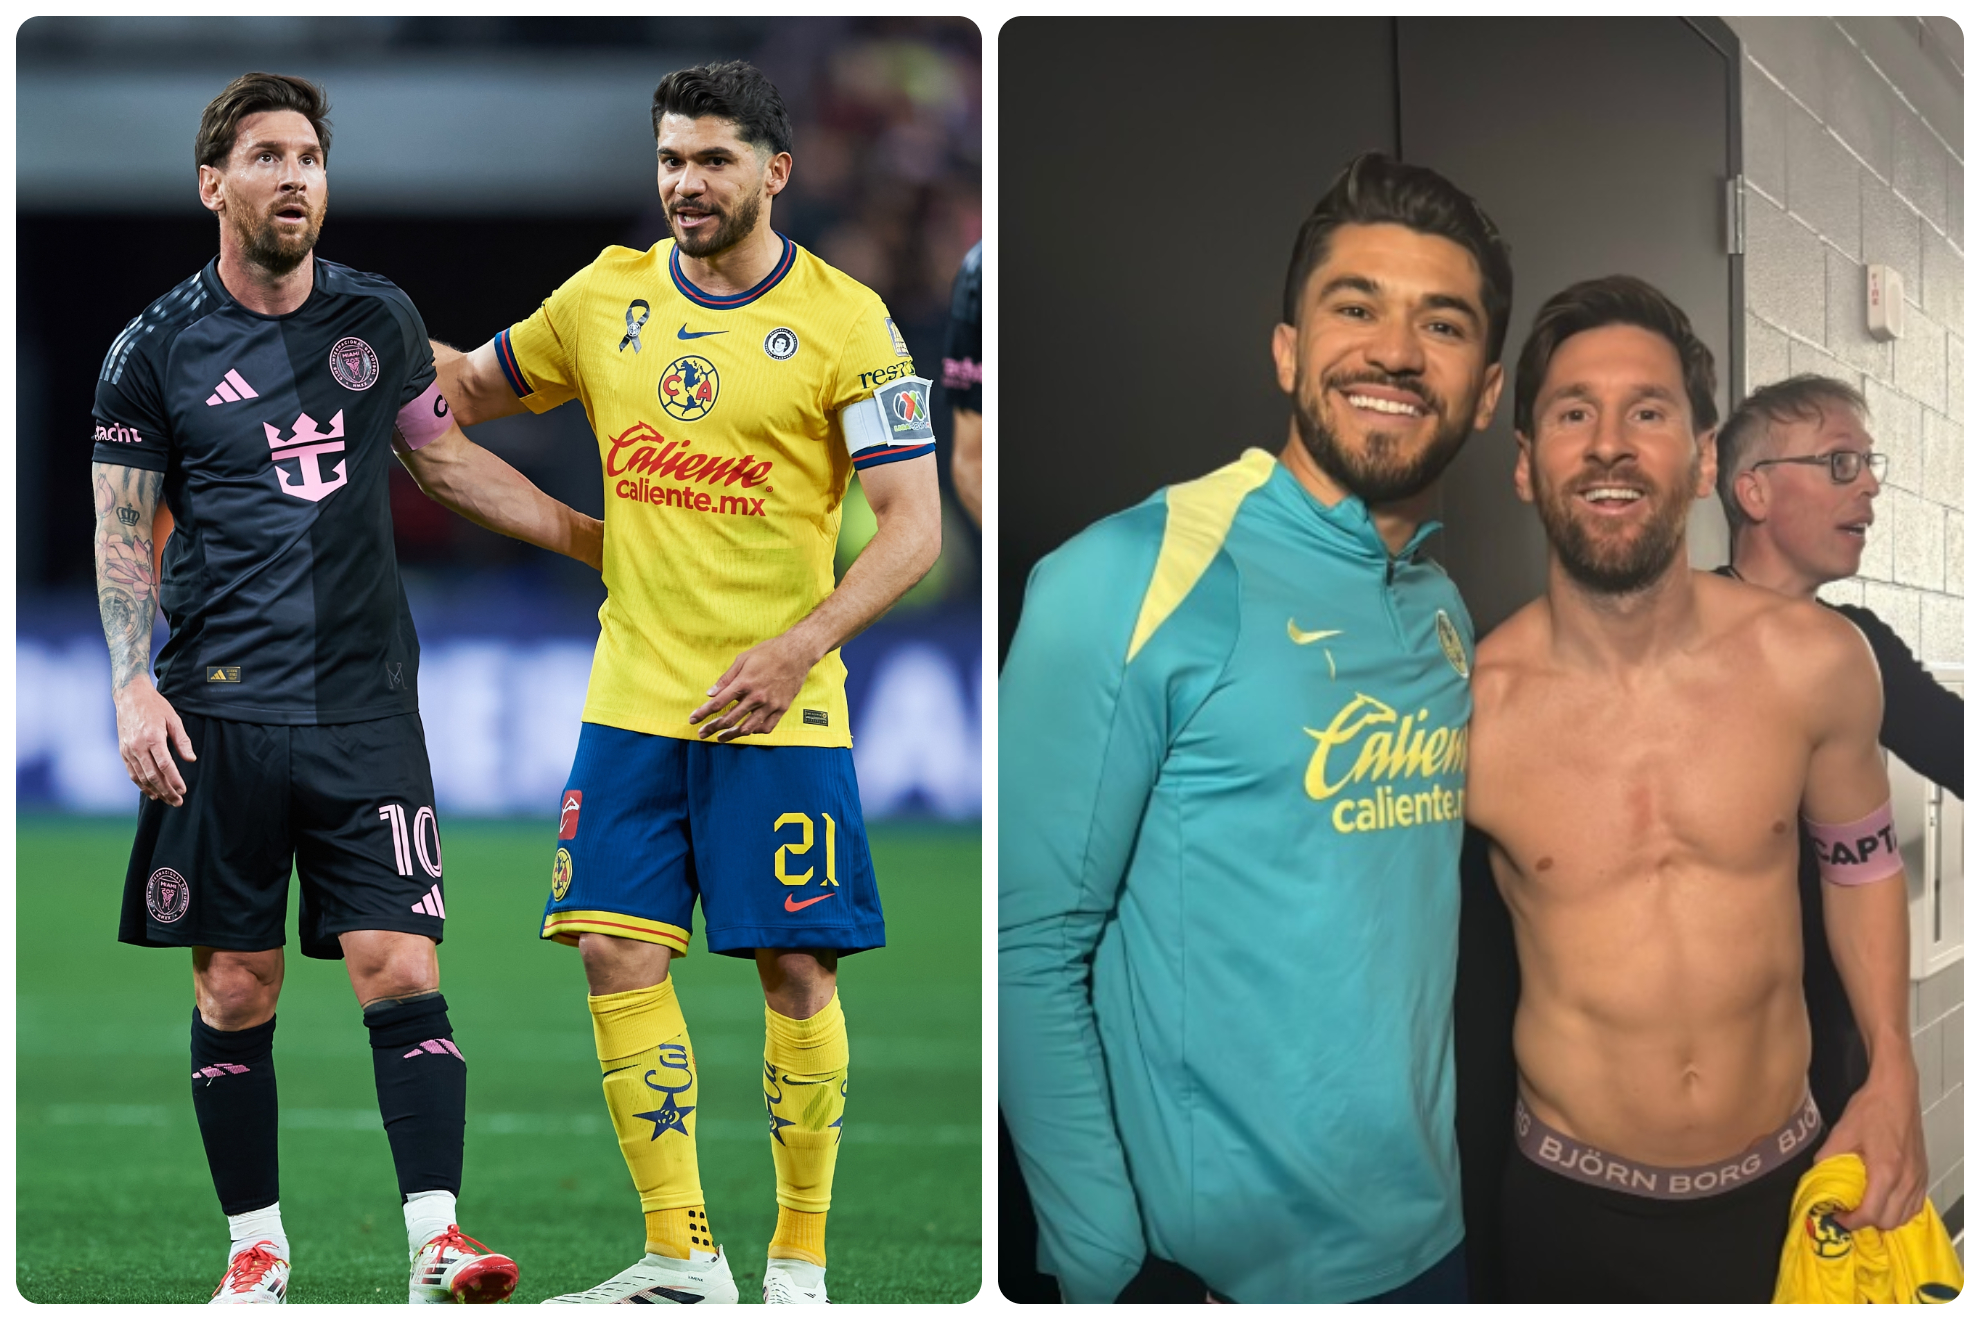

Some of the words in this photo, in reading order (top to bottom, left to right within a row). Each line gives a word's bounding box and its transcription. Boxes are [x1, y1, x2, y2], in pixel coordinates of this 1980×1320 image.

[606, 420, 773, 489] Caliente
[615, 477, 767, 517] caliente.mx
[1303, 691, 1468, 801] Calien
[1331, 783, 1464, 834] caliente.
[378, 804, 442, 879] 10
[774, 811, 840, 887] 21
[1814, 824, 1898, 866] CAPT
[1538, 1135, 1658, 1192] BJÖRN
[1668, 1153, 1762, 1194] BORG
